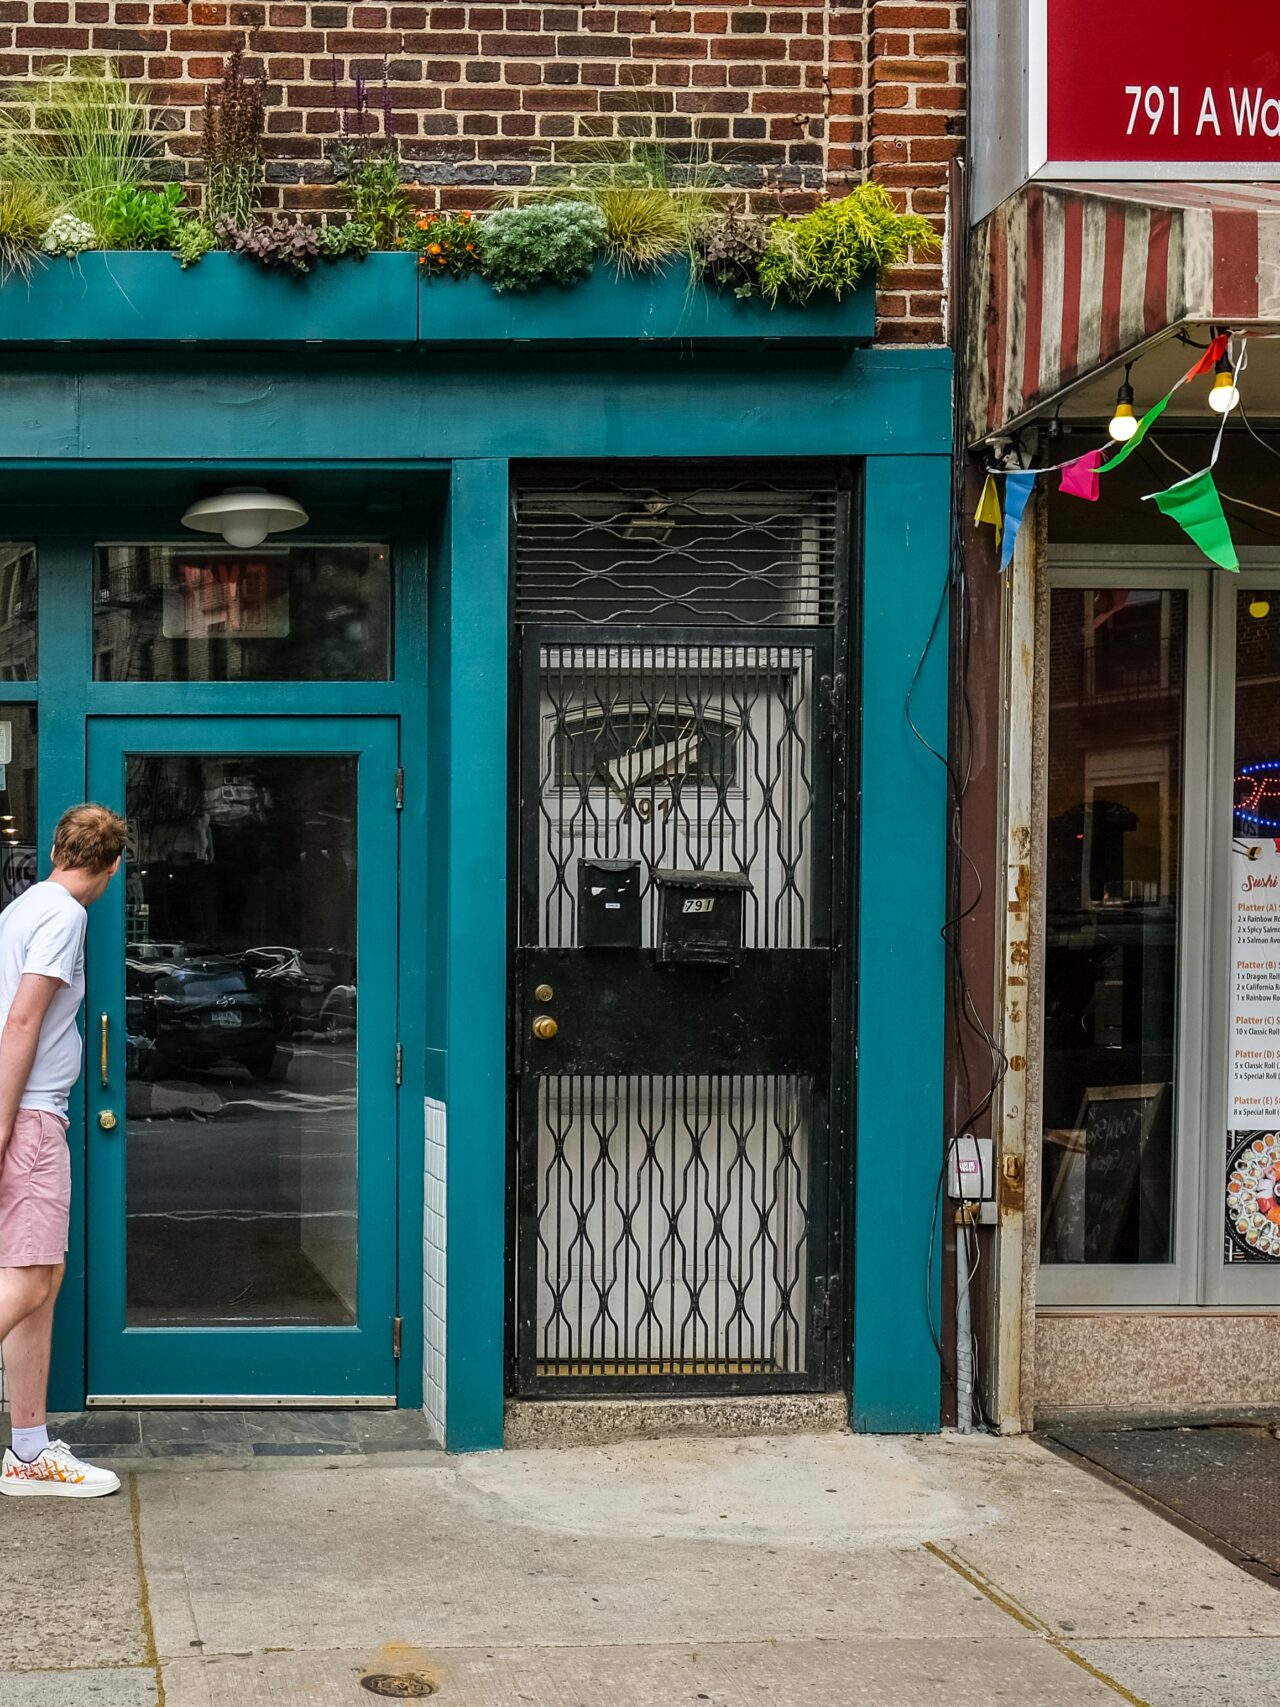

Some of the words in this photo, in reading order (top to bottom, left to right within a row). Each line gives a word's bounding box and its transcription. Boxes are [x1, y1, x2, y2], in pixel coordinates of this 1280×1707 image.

[1124, 86, 1180, 136] 791
[1195, 87, 1221, 136] A
[1229, 87, 1280, 137] Wa
[1241, 874, 1278, 892] Sushi
[684, 900, 711, 912] 791
[1247, 926, 1262, 934] Spicy
[1246, 973, 1268, 981] Dragon
[1236, 1016, 1263, 1024] Platter
[1236, 1050, 1262, 1058] Platter
[1234, 1096, 1261, 1104] Platter
[1243, 1108, 1264, 1116] Special
